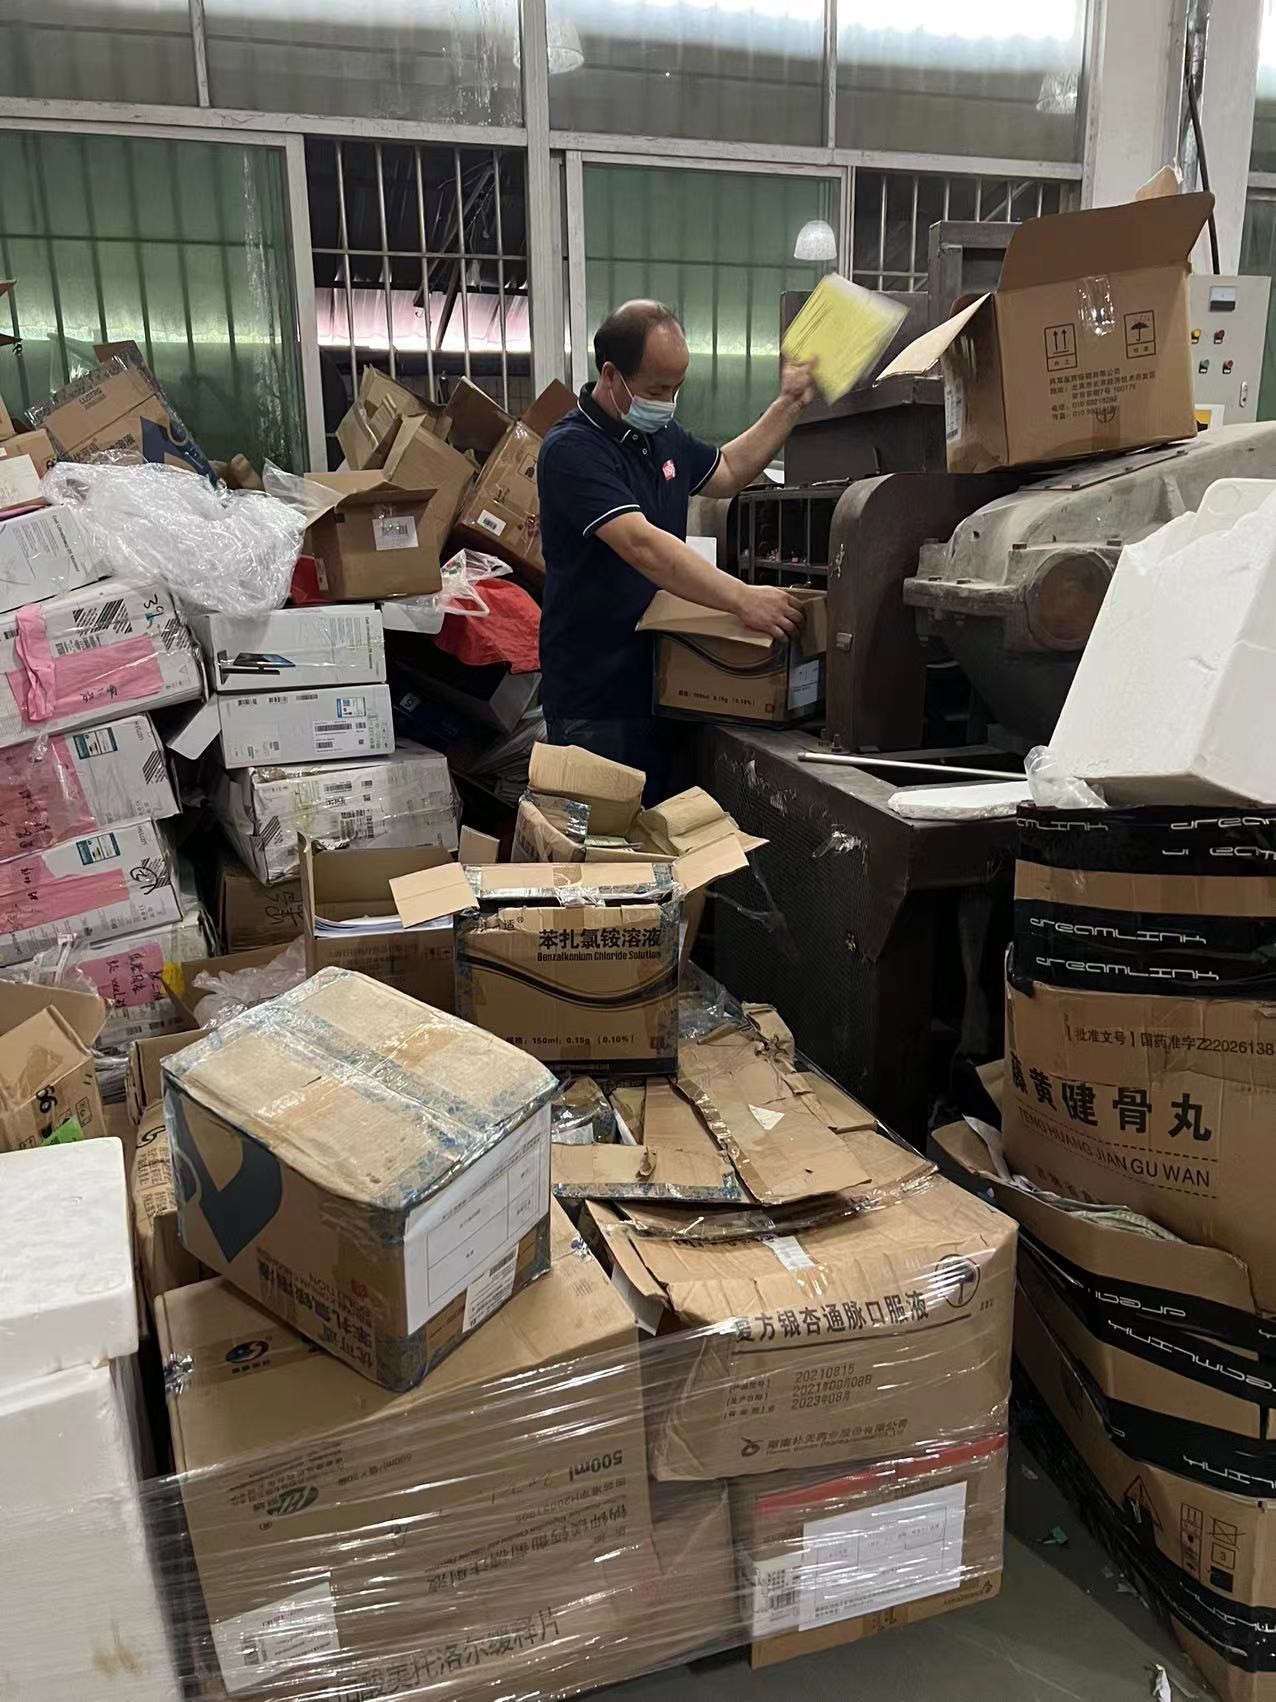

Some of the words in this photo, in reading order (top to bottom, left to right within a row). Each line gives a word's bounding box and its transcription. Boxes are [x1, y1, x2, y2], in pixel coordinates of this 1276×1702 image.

[537, 950, 593, 962] Benzalkonium
[593, 950, 628, 962] Chloride
[628, 949, 662, 961] Solution
[538, 927, 662, 950] 苯扎氯铵溶液
[1010, 1050, 1212, 1142] 藤黄健骨丸
[1017, 1105, 1046, 1134] TENG
[1047, 1125, 1091, 1155] HUANG
[1130, 1157, 1159, 1178] GU
[1162, 1165, 1211, 1188] WAN
[734, 1289, 929, 1344] 复方银杏通脉口服液
[795, 1363, 855, 1384] 20210815
[568, 1448, 624, 1483] 500ml
